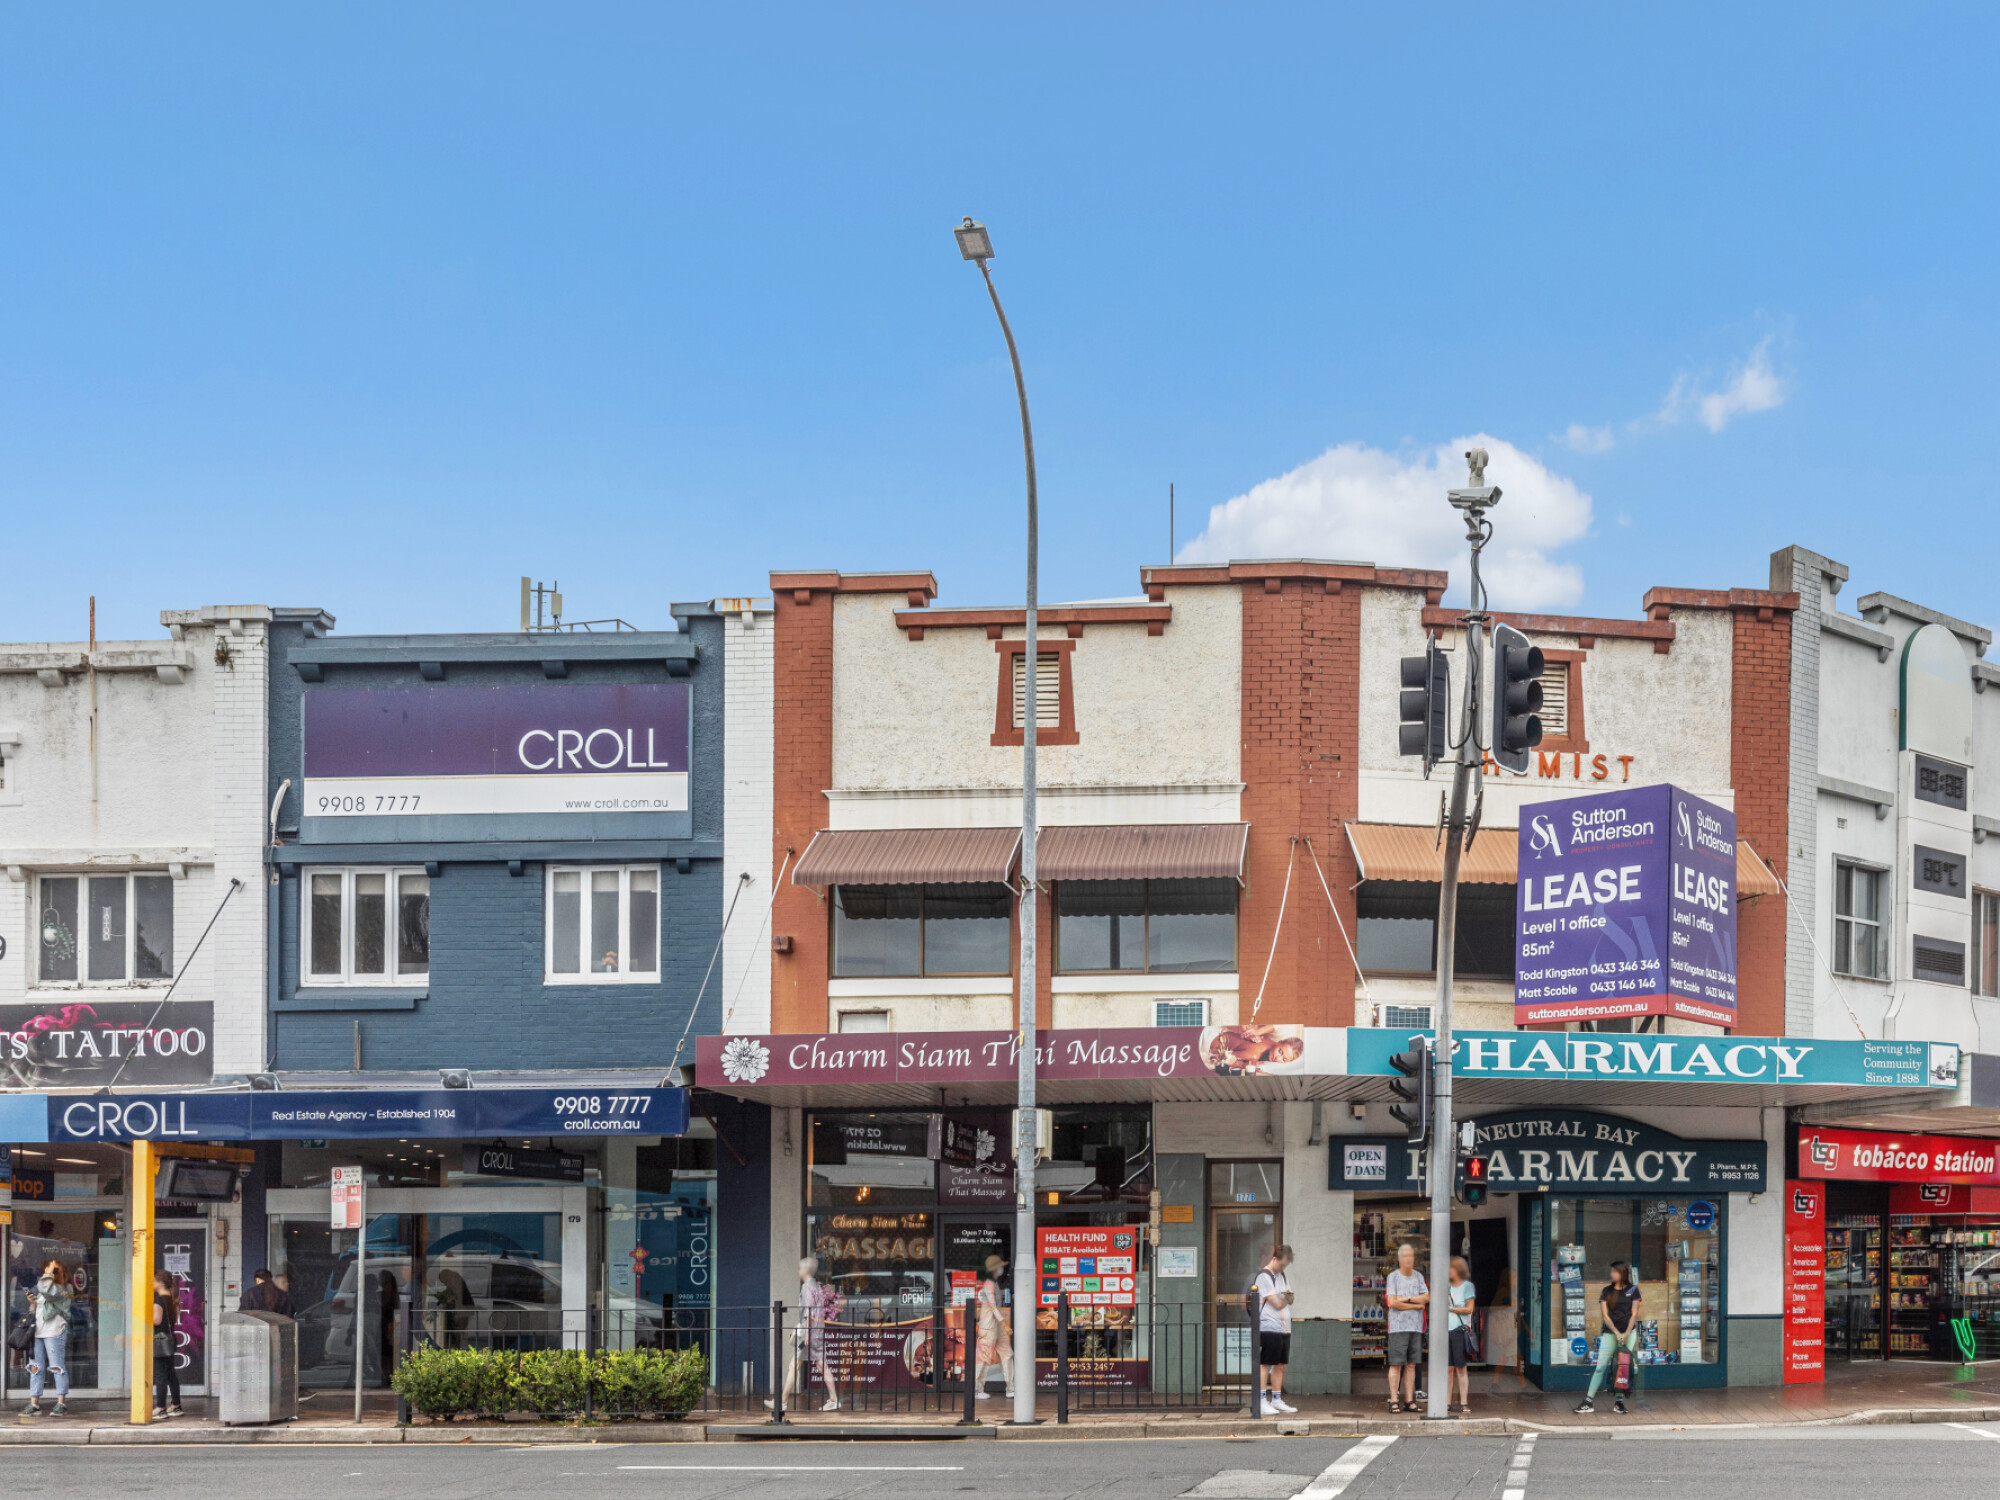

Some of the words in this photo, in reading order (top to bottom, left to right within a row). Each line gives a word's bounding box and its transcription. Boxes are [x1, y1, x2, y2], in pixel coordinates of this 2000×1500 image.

[519, 728, 669, 771] CROLL
[1470, 750, 1634, 783] HMIST
[318, 796, 365, 812] 9908
[376, 796, 421, 812] 7777
[1572, 808, 1626, 827] Sutton
[1696, 810, 1722, 836] Sutton
[1571, 821, 1654, 845] Anderson
[1696, 827, 1733, 856] Anderson
[1524, 864, 1642, 912] LEASE
[1674, 862, 1729, 916] LEASE
[1523, 918, 1556, 935] Level
[1560, 918, 1566, 932] 1
[1568, 915, 1607, 930] office
[1673, 908, 1691, 927] Level
[1692, 914, 1696, 927] 1
[1696, 916, 1714, 934] office
[1522, 940, 1555, 957] 85m²
[1519, 970, 1543, 981] Todd
[1545, 966, 1588, 980] Kingston
[1590, 963, 1616, 974] 0433
[1618, 960, 1638, 972] 346
[1640, 958, 1660, 970] 346
[1670, 958, 1684, 970] Todd
[1684, 962, 1705, 977] Kingston
[1706, 968, 1717, 980] 0433
[1718, 971, 1726, 982] 346
[1728, 974, 1736, 986] 346
[1518, 987, 1542, 999] Matt
[1544, 984, 1578, 997] Scoble
[1590, 981, 1616, 993] 0433
[1618, 979, 1636, 990] 146
[1638, 978, 1656, 989] 146
[1670, 976, 1682, 988] Matt
[1683, 980, 1700, 994] Scoble
[1705, 986, 1716, 998] 0433
[1528, 1002, 1648, 1020] suttonanderson.com.au
[1675, 1002, 1732, 1023] suttonanderson.com.au
[50, 1027, 206, 1058] TATTOO
[1864, 1042, 1904, 1056] Serving
[1906, 1044, 1922, 1055] the
[788, 1037, 888, 1070] Charm
[898, 1041, 972, 1068] Siam
[1067, 1040, 1192, 1077] Massage
[1864, 1057, 1922, 1071] Community
[1866, 1072, 1894, 1084] Since
[1896, 1072, 1920, 1084] 1898
[554, 1096, 600, 1114] 9908
[608, 1096, 652, 1114] 7777
[63, 1100, 198, 1137] CROLL
[272, 1111, 294, 1120] Real
[296, 1110, 326, 1120] Estate
[328, 1110, 367, 1122] Agency
[376, 1110, 430, 1119] Established
[434, 1110, 456, 1118] 1904
[564, 1119, 640, 1130] croll.com.au
[1476, 1120, 1586, 1144] NEUTRAL
[1595, 1123, 1640, 1146] BAY
[482, 1151, 514, 1170] CROLL
[1349, 1150, 1382, 1160] OPEN
[1811, 1136, 1839, 1171] tsg
[1854, 1144, 1928, 1170] tobacco
[1934, 1150, 1994, 1174] station
[1346, 1166, 1352, 1176] 7
[1354, 1166, 1384, 1176] DAYS
[1406, 1149, 1697, 1184] PARMACY
[1708, 1172, 1718, 1180] Ph
[1722, 1172, 1742, 1180] 9953
[1744, 1172, 1760, 1180] 1126
[952, 1176, 979, 1186] Charm
[982, 1176, 1003, 1185] Siam
[948, 1187, 969, 1196] Thai
[972, 1188, 1006, 1200] Massage
[832, 1214, 868, 1229] Charm
[870, 1215, 898, 1228] Siam
[962, 1229, 977, 1237] Open
[983, 1229, 996, 1237] Days
[1045, 1234, 1080, 1242] HEALTH
[1082, 1234, 1107, 1242] FUND
[690, 1217, 708, 1286] CROLL
[1044, 1246, 1071, 1254] REBATE
[1072, 1246, 1108, 1254] Available!
[1792, 1244, 1822, 1252] Accessories
[902, 1293, 924, 1304] OPEN
[1792, 1362, 1822, 1370] Accessories
